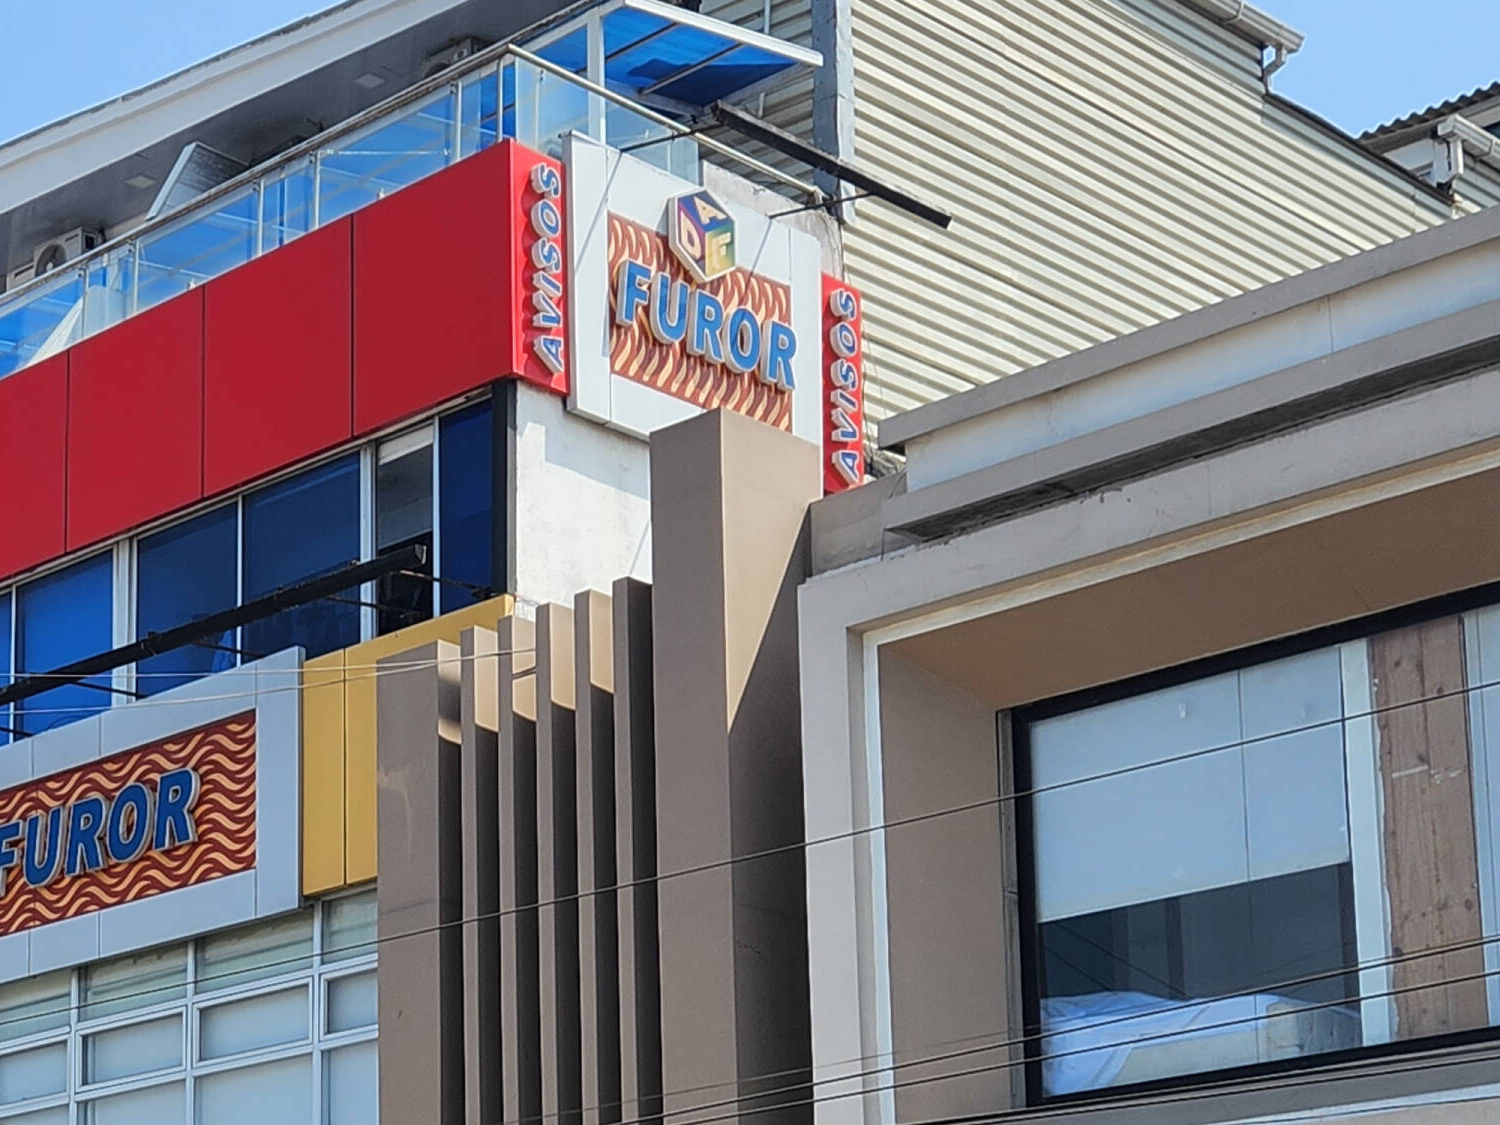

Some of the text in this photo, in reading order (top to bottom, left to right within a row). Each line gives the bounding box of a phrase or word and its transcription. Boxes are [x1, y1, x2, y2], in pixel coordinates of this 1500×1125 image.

[531, 162, 564, 375] AVISOS
[614, 258, 798, 392] FUROR
[828, 288, 861, 486] AVISOS
